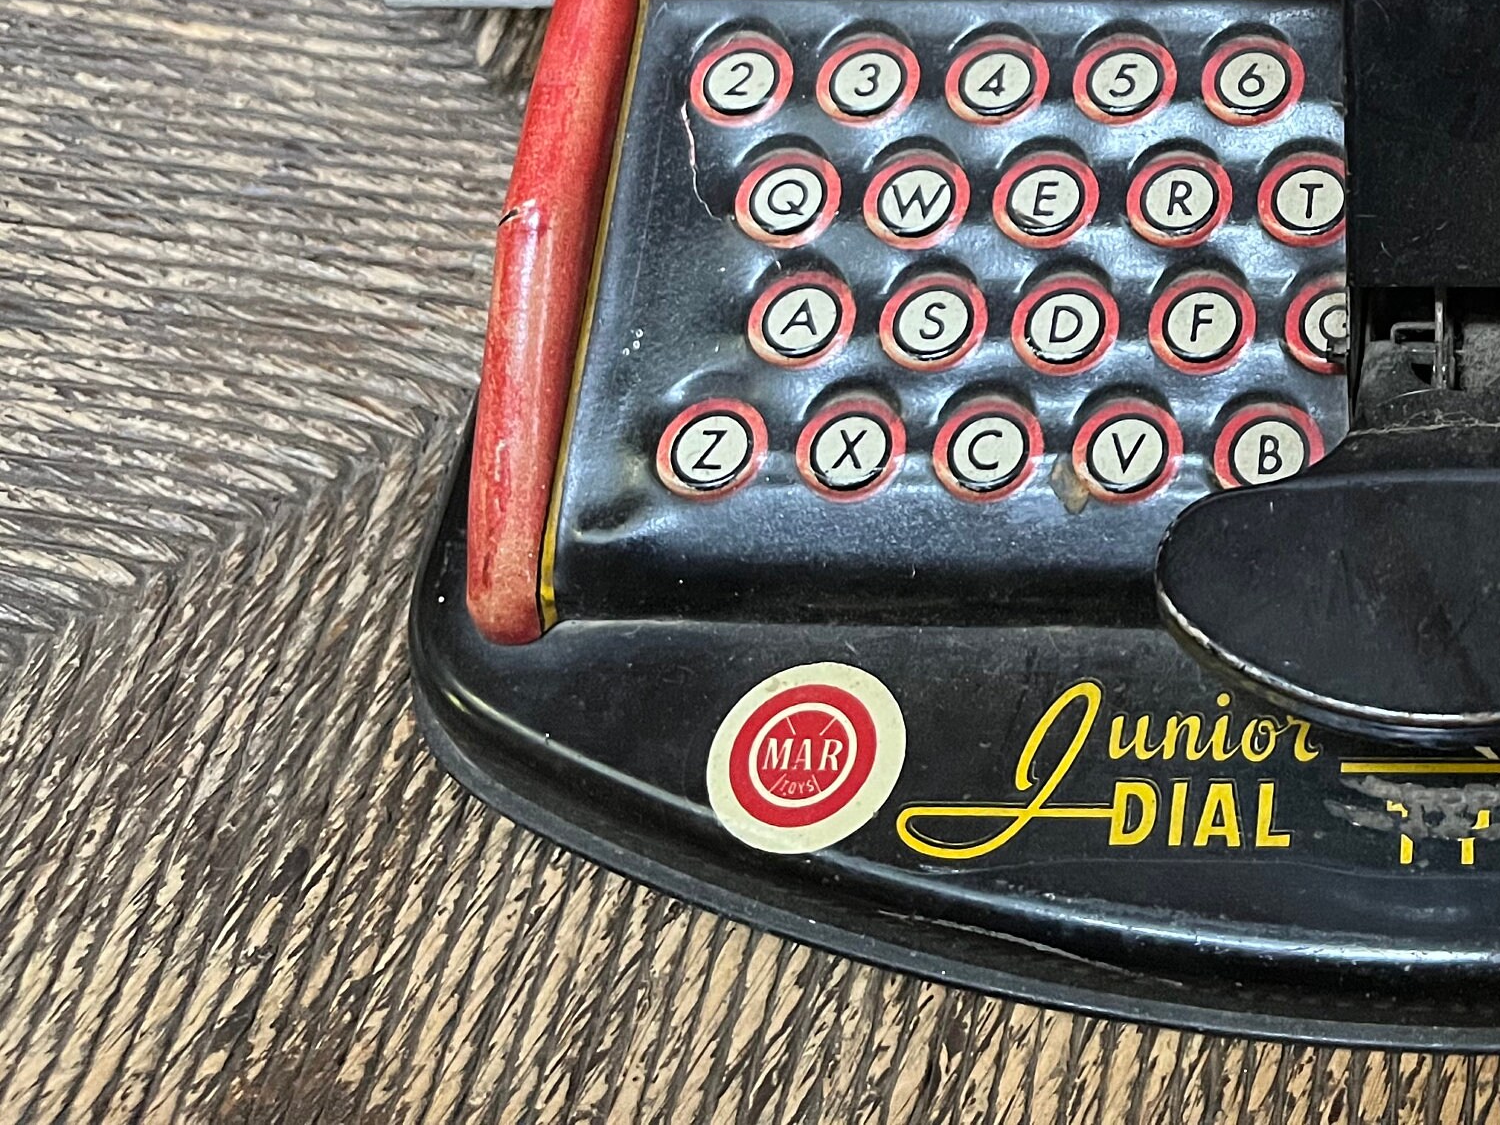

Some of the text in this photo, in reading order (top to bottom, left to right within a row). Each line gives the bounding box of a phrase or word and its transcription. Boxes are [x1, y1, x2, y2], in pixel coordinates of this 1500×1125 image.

[725, 63, 753, 95] 2
[855, 64, 880, 96] 3
[979, 64, 1005, 96] 4
[1109, 64, 1137, 97] 5
[1238, 63, 1264, 97] 6
[768, 180, 807, 215] Q
[892, 184, 948, 218] W
[1033, 182, 1058, 216] E
[1167, 181, 1192, 215] R
[1300, 184, 1323, 218] T
[781, 299, 816, 335] A
[920, 303, 946, 339] S
[1049, 306, 1082, 343] D
[1190, 304, 1214, 342] F
[692, 431, 727, 469] Z
[832, 430, 867, 469] X
[968, 430, 1002, 470] C
[1112, 433, 1146, 473] V
[1258, 435, 1282, 474] B
[761, 737, 844, 772] MAR
[896, 681, 1320, 860] Junior
[779, 779, 815, 797] TOYS
[1108, 780, 1291, 847] DIAL
